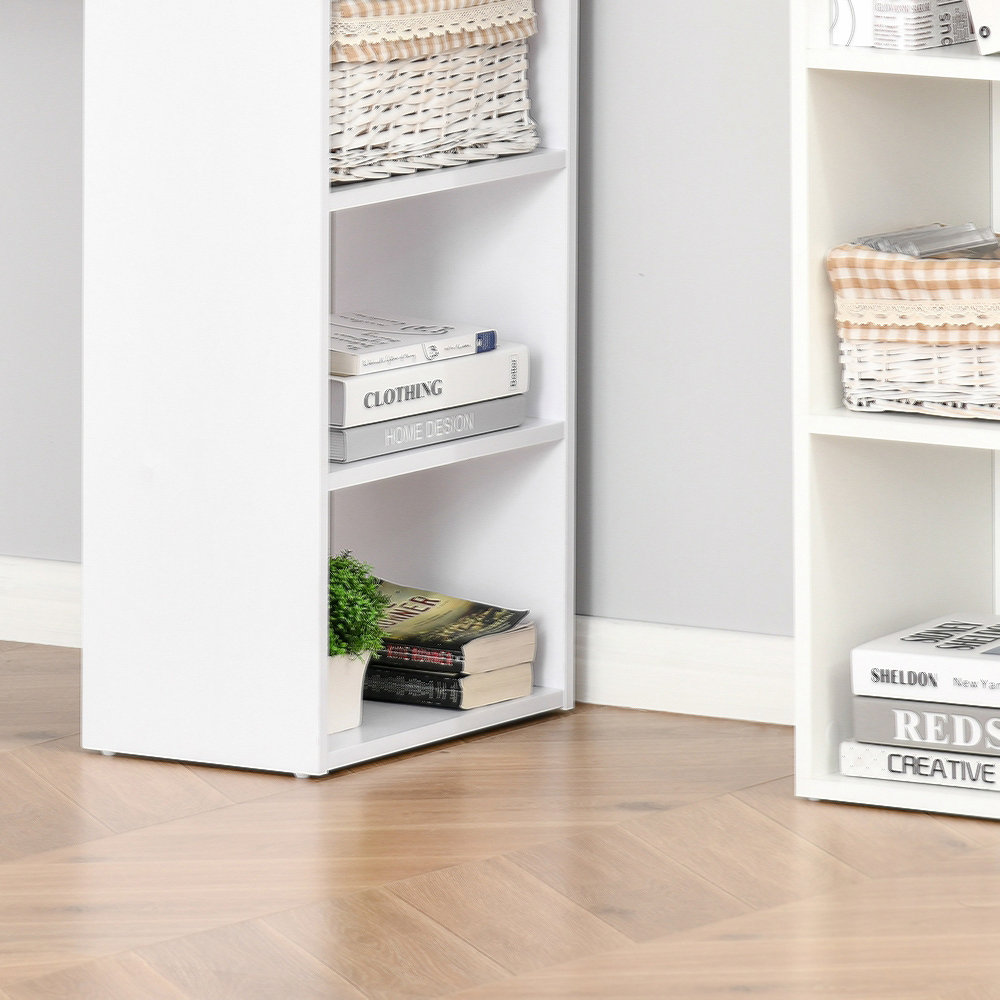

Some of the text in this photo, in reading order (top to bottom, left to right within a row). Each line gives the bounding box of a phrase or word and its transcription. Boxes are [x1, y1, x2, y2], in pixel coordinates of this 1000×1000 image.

[363, 379, 443, 409] CLOTHING
[384, 422, 424, 447] HOME
[870, 667, 939, 689] SHELDON
[953, 677, 978, 689] New
[887, 753, 997, 784] CREATIVE
